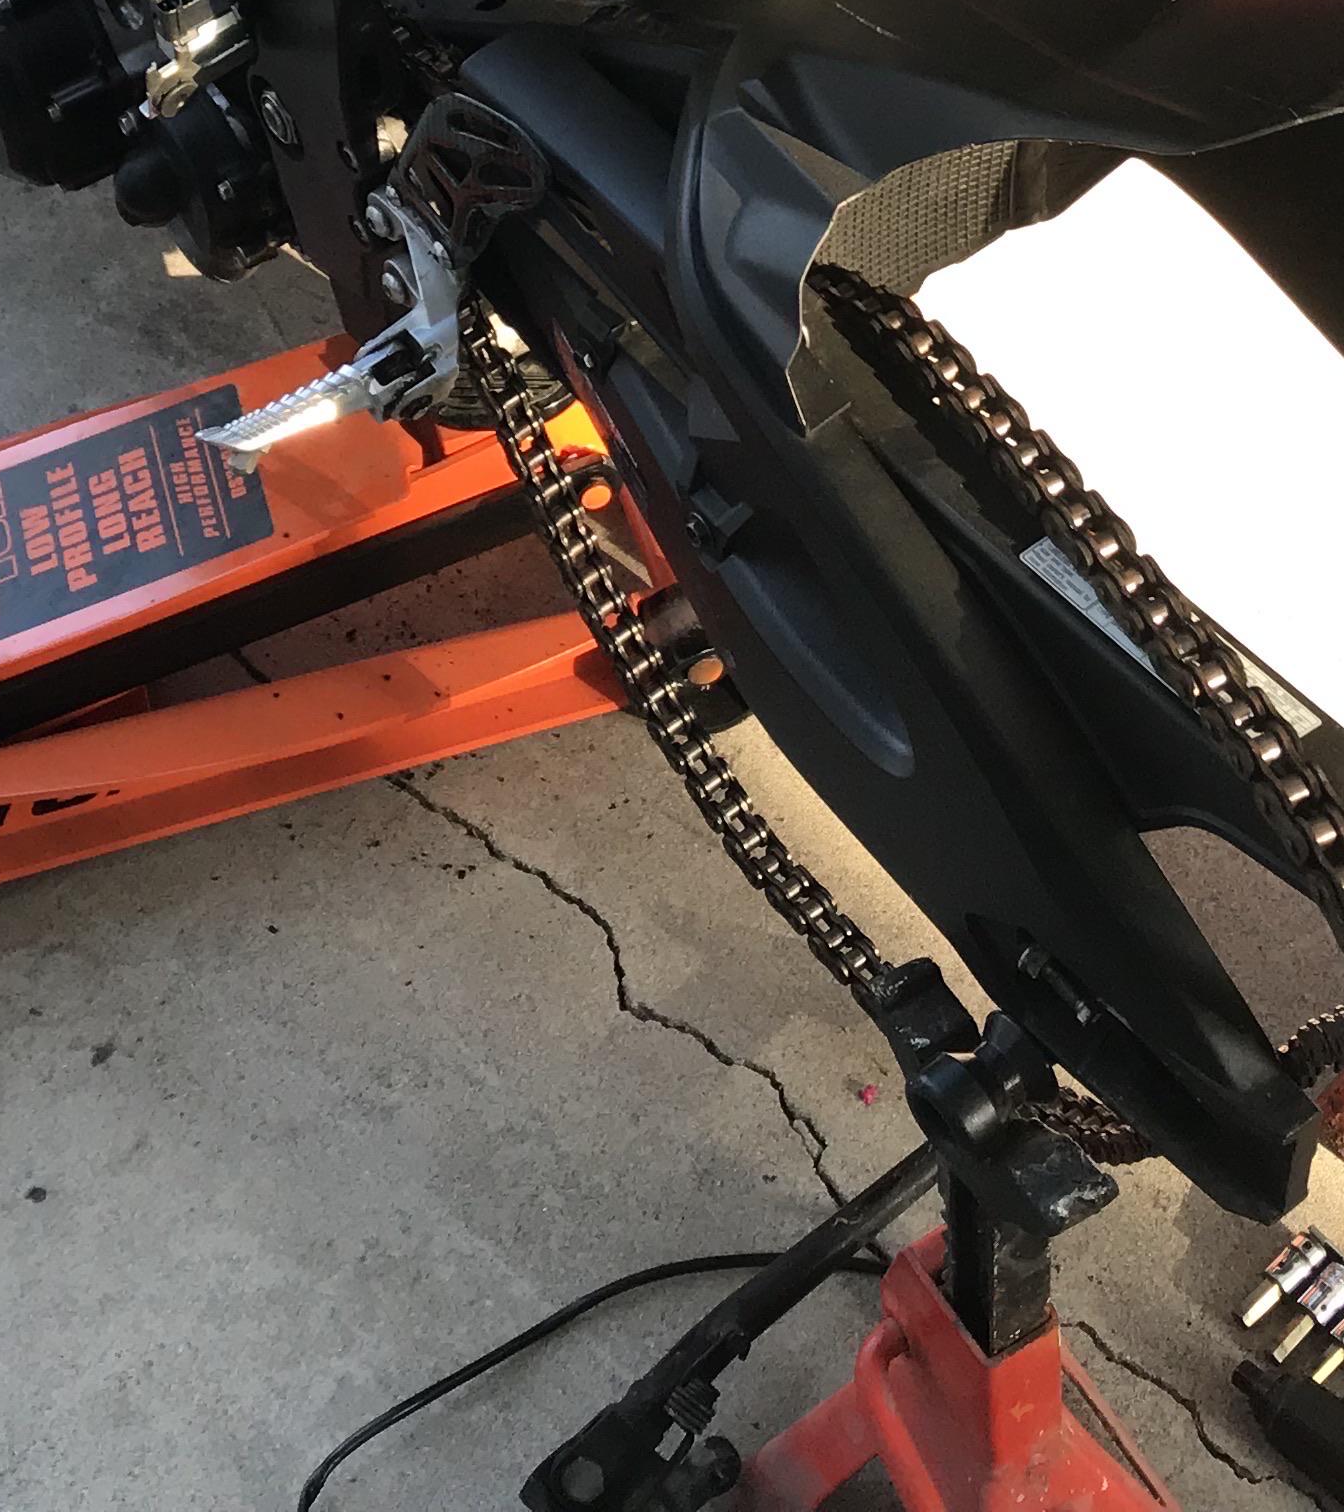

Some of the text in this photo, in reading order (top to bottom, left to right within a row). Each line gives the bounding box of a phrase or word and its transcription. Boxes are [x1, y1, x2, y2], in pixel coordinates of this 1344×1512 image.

[88, 468, 131, 555] LONG
[118, 447, 167, 553] REACH
[169, 460, 194, 505] HIGH
[175, 415, 220, 538] PERFORMANCE
[19, 505, 59, 576] LOW
[46, 461, 98, 593] PROFILE
